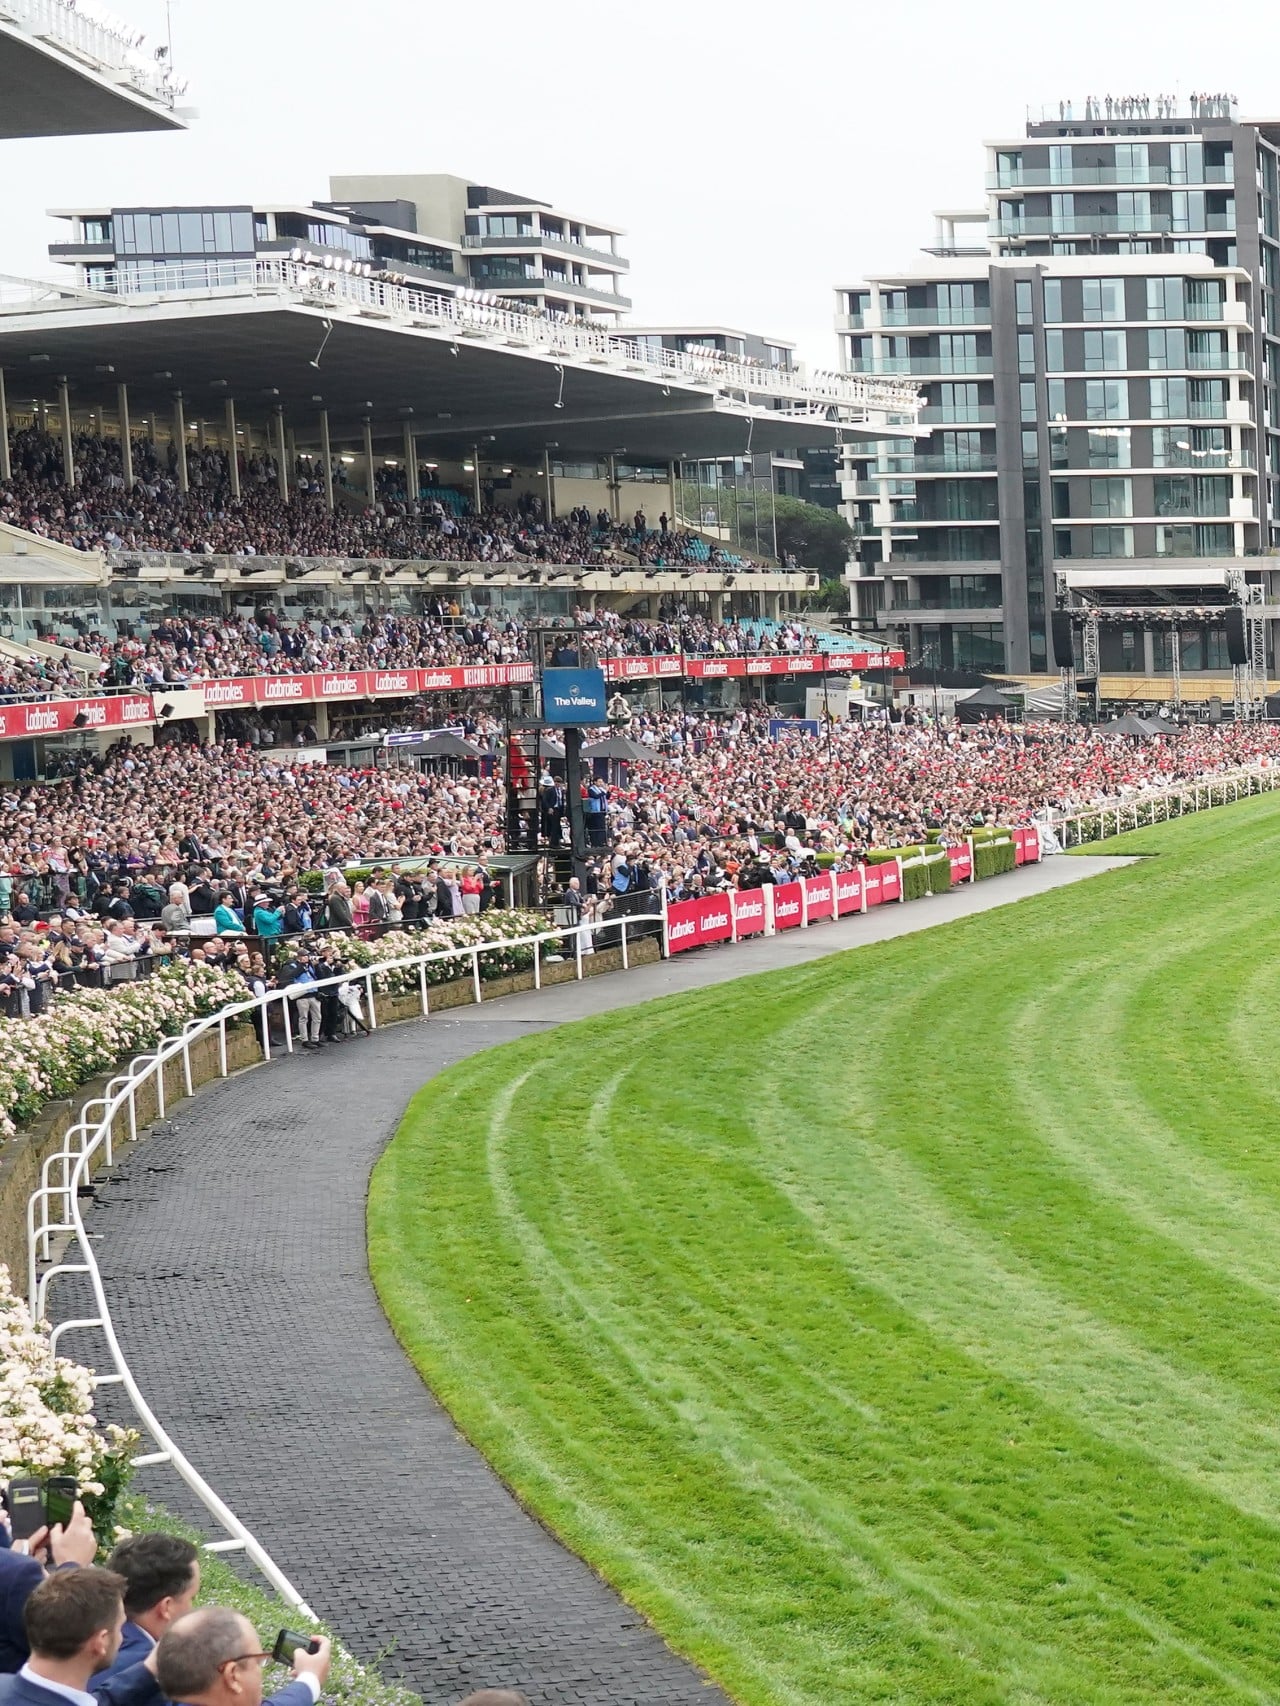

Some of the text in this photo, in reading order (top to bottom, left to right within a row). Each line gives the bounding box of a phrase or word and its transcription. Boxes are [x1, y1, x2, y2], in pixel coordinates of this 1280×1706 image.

[323, 676, 357, 695] Ladbrokes
[376, 672, 408, 691] Ladbrokes
[425, 672, 452, 688] Ladbrokes
[464, 669, 488, 686] WELCOME
[489, 668, 496, 684] TO
[497, 667, 506, 683] THE
[203, 682, 244, 702] Ladbrokes
[265, 678, 303, 698] Ladbrokes
[122, 699, 149, 721] Ladbrokes
[554, 696, 597, 707] The Valley
[25, 707, 59, 732] Ladbrokes
[775, 900, 800, 918] Ladbrokes
[669, 919, 696, 940] Ladbrokes
[701, 911, 728, 931] Ladbrokes
